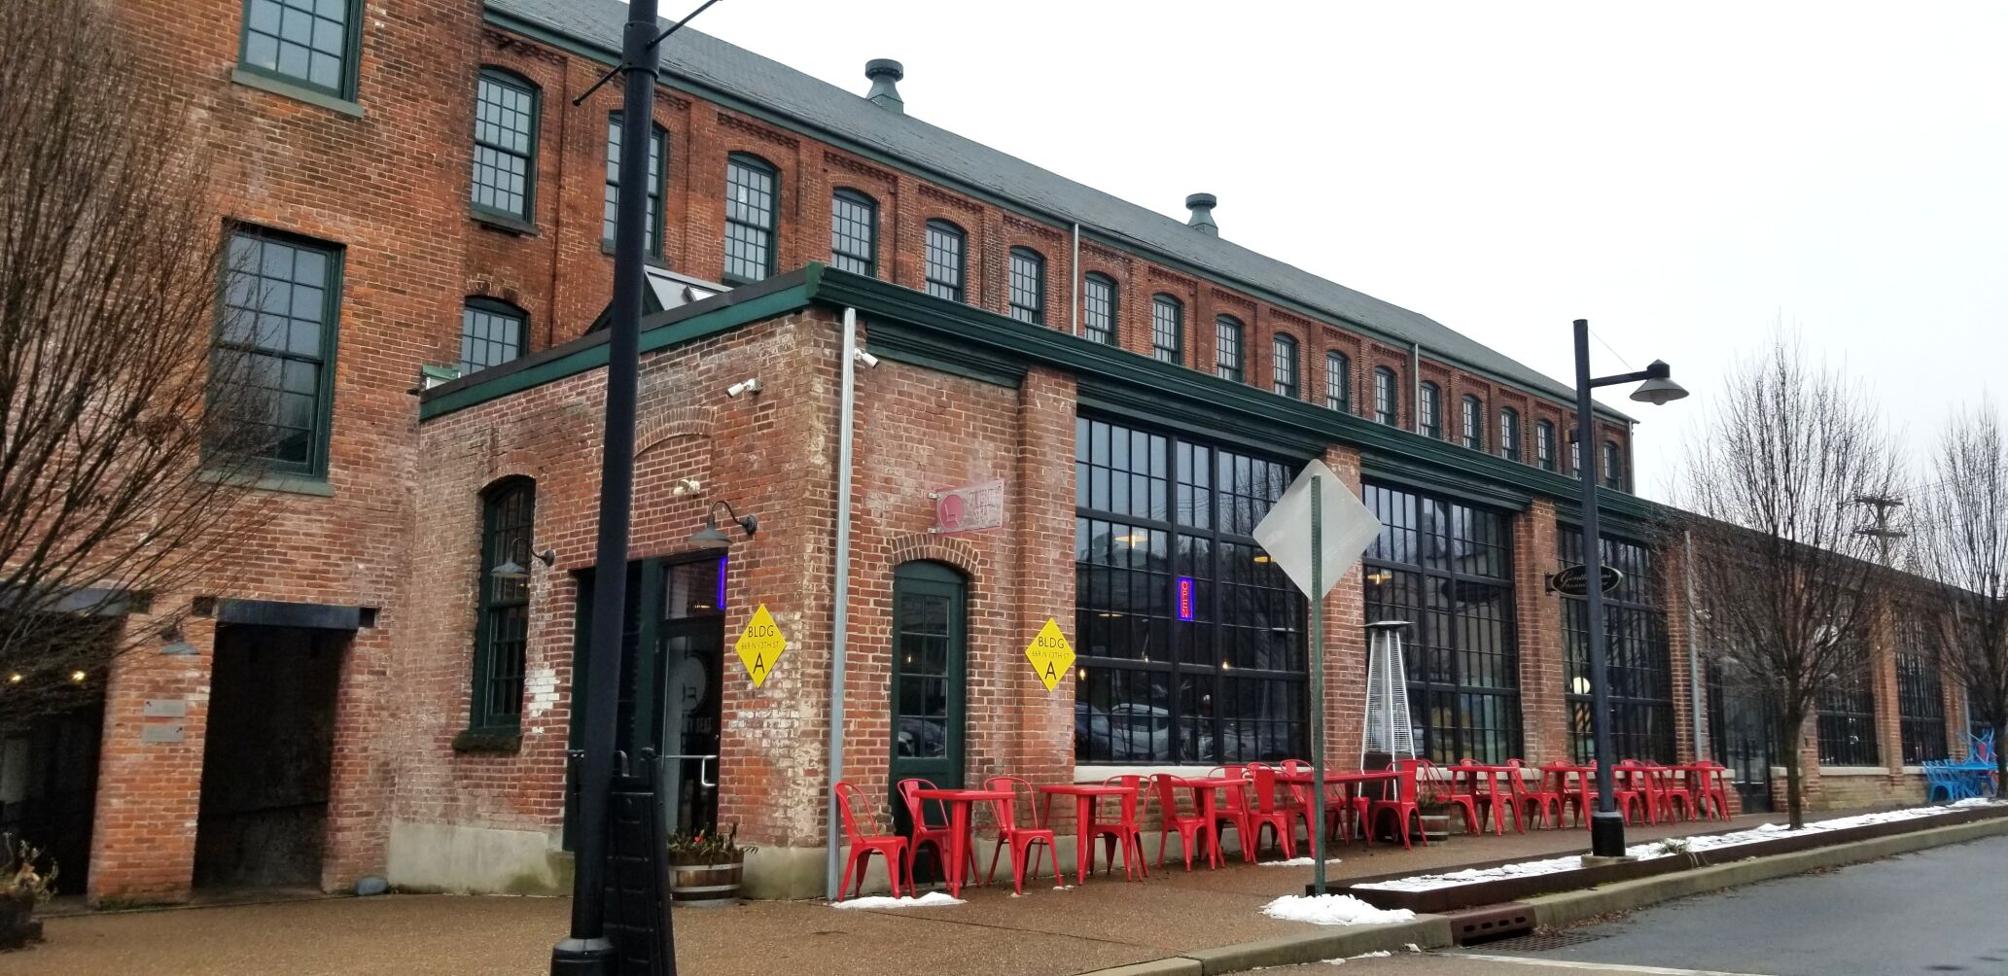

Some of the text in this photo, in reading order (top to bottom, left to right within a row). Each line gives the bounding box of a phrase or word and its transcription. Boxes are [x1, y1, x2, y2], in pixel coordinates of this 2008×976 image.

[1180, 580, 1189, 618] OPEN
[748, 625, 774, 638] BLDG
[1038, 636, 1065, 649] BLDG
[752, 652, 765, 674] A
[1044, 660, 1057, 680] A
